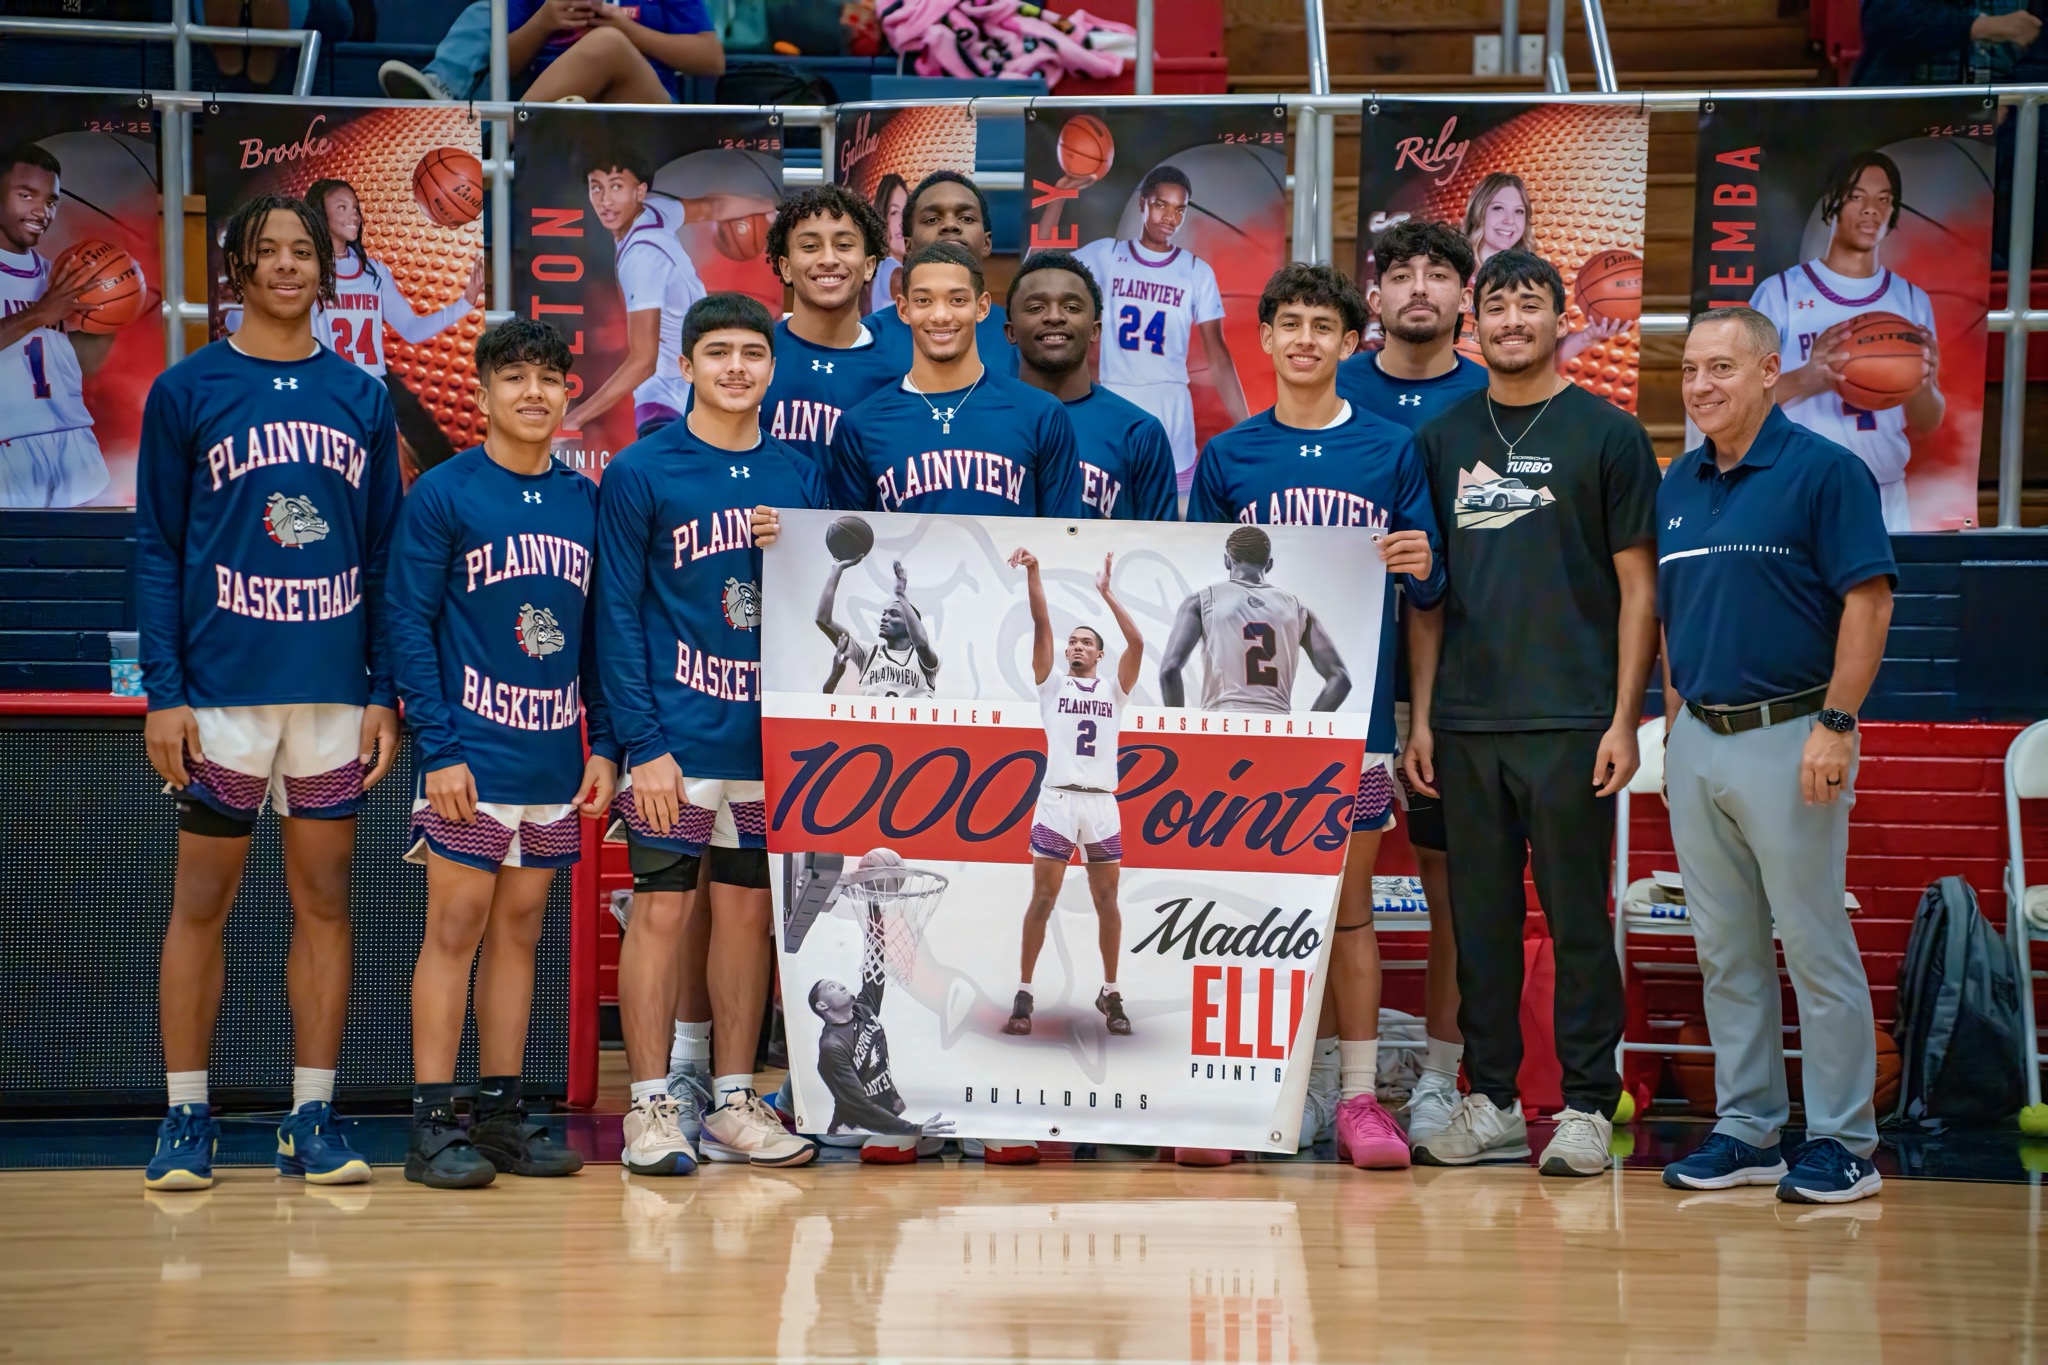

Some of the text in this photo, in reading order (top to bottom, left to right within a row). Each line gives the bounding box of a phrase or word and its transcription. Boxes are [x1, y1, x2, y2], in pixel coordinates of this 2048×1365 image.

[239, 115, 333, 170] Brooke
[1395, 115, 1470, 186] Riley
[1708, 146, 1761, 308] EMBA
[1111, 277, 1185, 308] PLAINVIEW
[331, 317, 378, 365] 24
[1119, 304, 1167, 356] 24
[23, 336, 52, 399] 1
[207, 420, 367, 492] PLAINVIEW
[876, 449, 1026, 513] PLAINVIEW
[1506, 461, 1553, 473] TURBO
[671, 507, 757, 571] PLAIN
[214, 562, 362, 622] BASKETBALL
[868, 668, 920, 689] PLAINVIEW
[1242, 621, 1279, 688] 2
[830, 703, 1334, 736] PLAINVIEW BASKETBALL
[1058, 697, 1113, 718] PLAINVIEW
[1076, 719, 1097, 757] 2
[771, 741, 1356, 857] 1000 Points
[1191, 965, 1314, 1061] ELLI
[965, 1086, 1148, 1110] BULLDOGS
[1191, 1062, 1257, 1082] POINT
